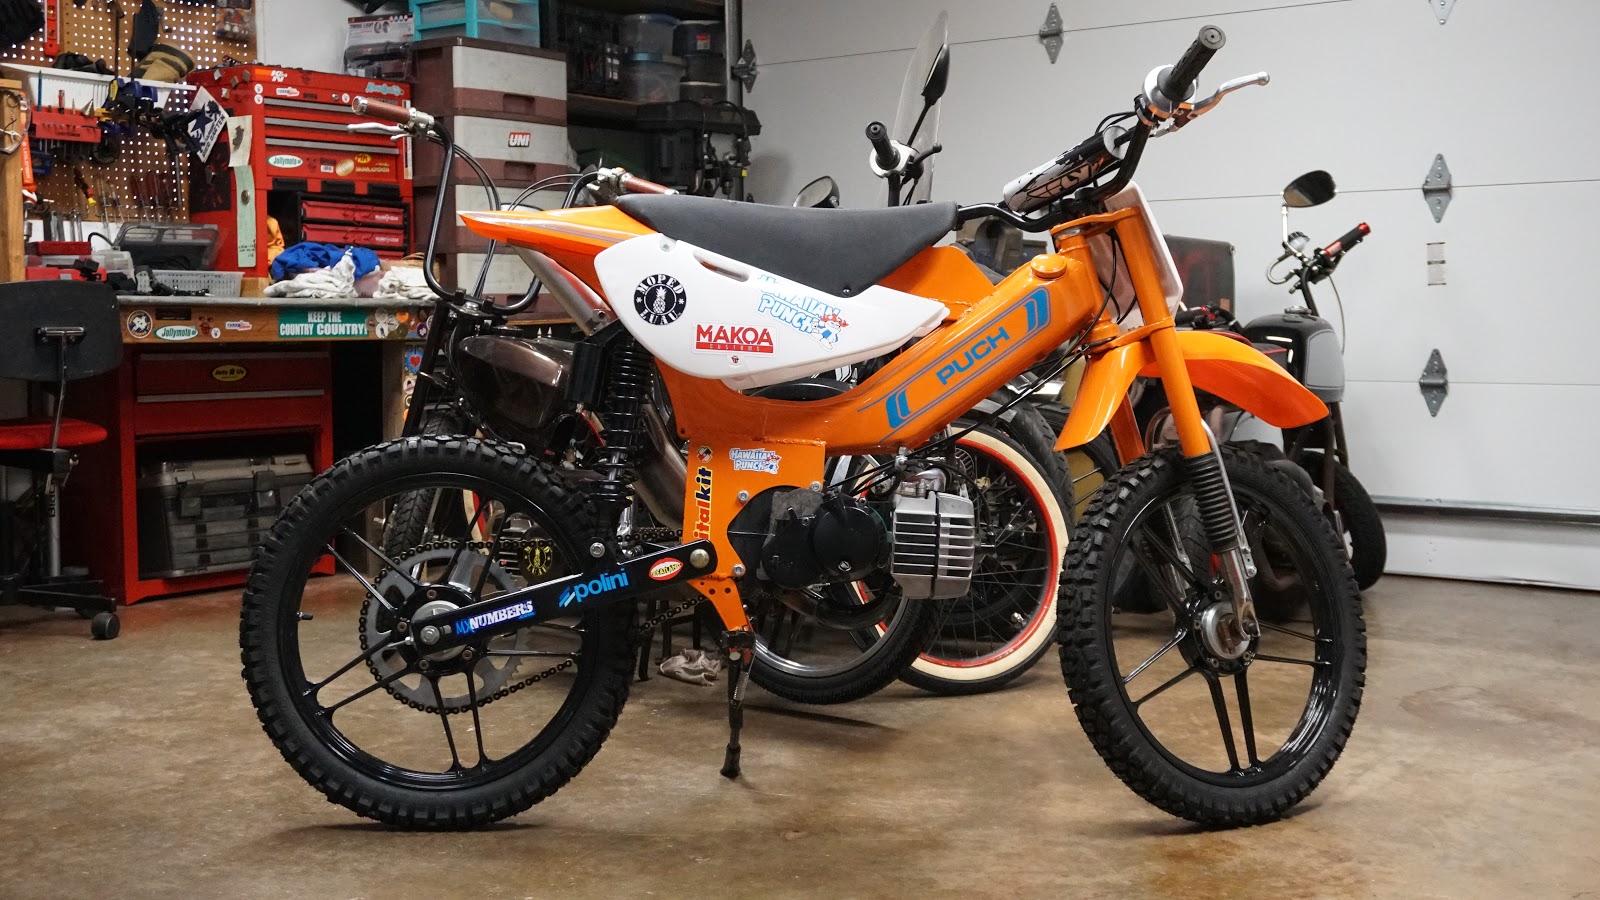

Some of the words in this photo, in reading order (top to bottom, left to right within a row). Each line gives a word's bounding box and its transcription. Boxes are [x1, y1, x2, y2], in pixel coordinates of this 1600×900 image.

[509, 133, 530, 147] UNI
[273, 157, 298, 166] Jollymoto
[636, 274, 684, 294] MOPED
[307, 311, 326, 323] KEEP
[328, 311, 342, 323] THE
[758, 294, 821, 335] PUNCH
[161, 328, 191, 338] Jollymoto
[280, 323, 314, 336] COUNTRY
[316, 323, 368, 336] COUNTRY!
[696, 324, 774, 346] MAKOA
[709, 344, 760, 352] CUSTOMS
[936, 326, 1010, 385] PUCH
[693, 466, 713, 540] italkit
[574, 568, 630, 603] polini
